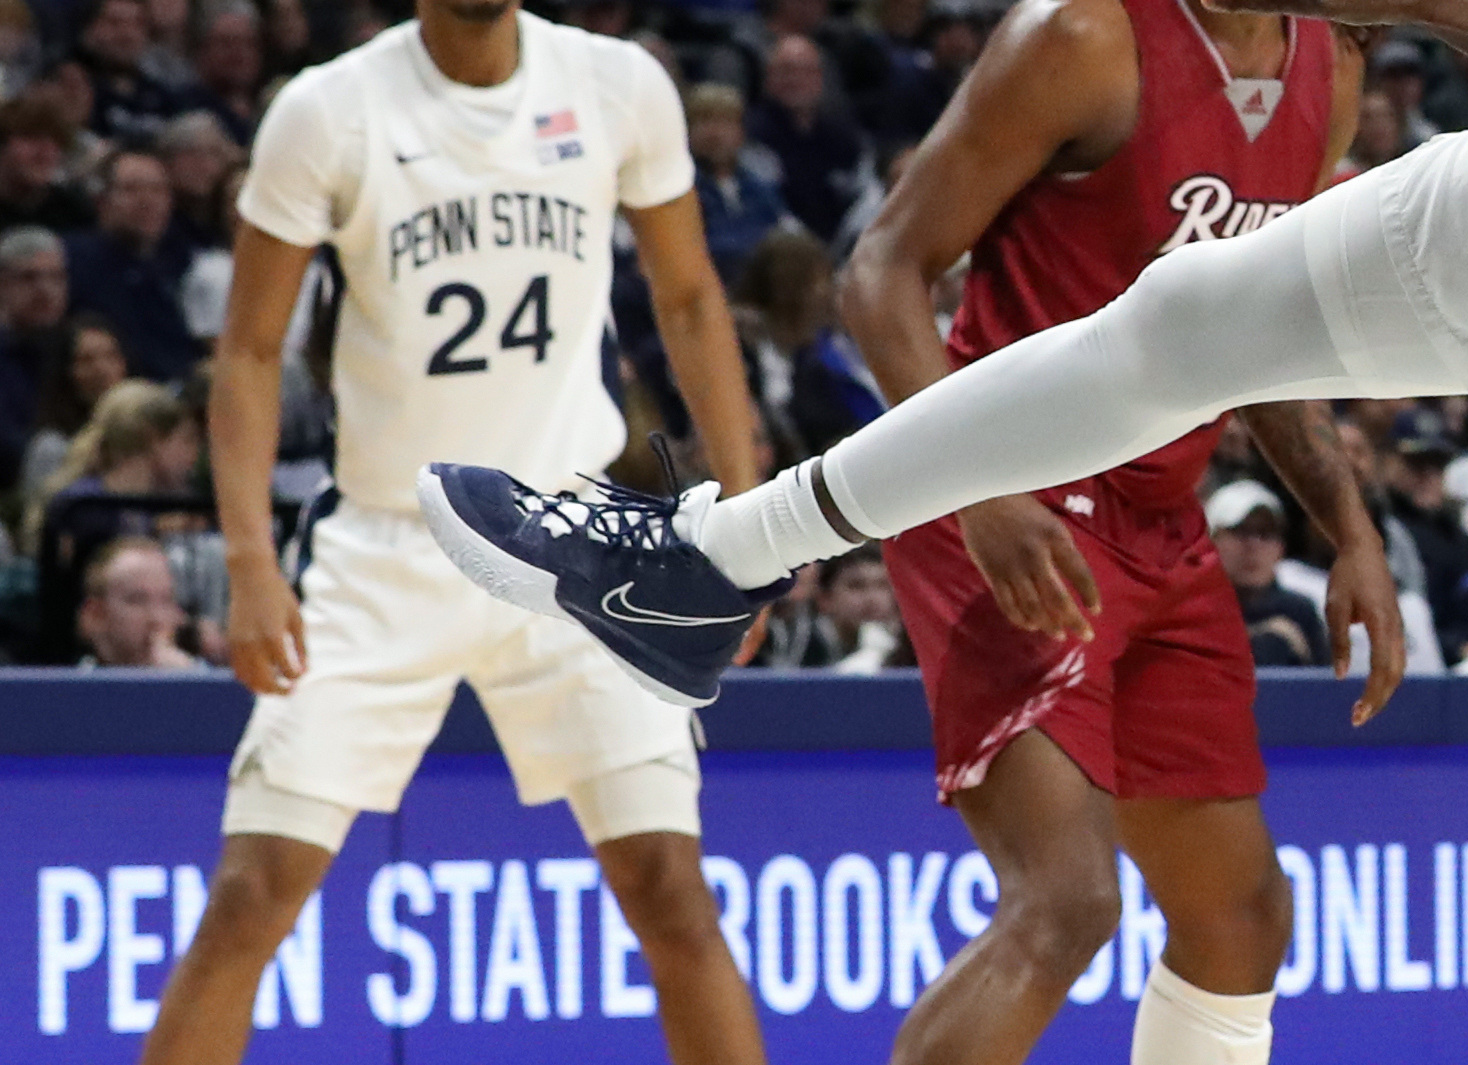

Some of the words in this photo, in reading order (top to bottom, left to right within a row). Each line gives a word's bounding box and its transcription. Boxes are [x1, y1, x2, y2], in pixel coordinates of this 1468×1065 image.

[390, 198, 479, 282] PENN
[493, 193, 589, 262] STATE
[426, 275, 554, 377] 24
